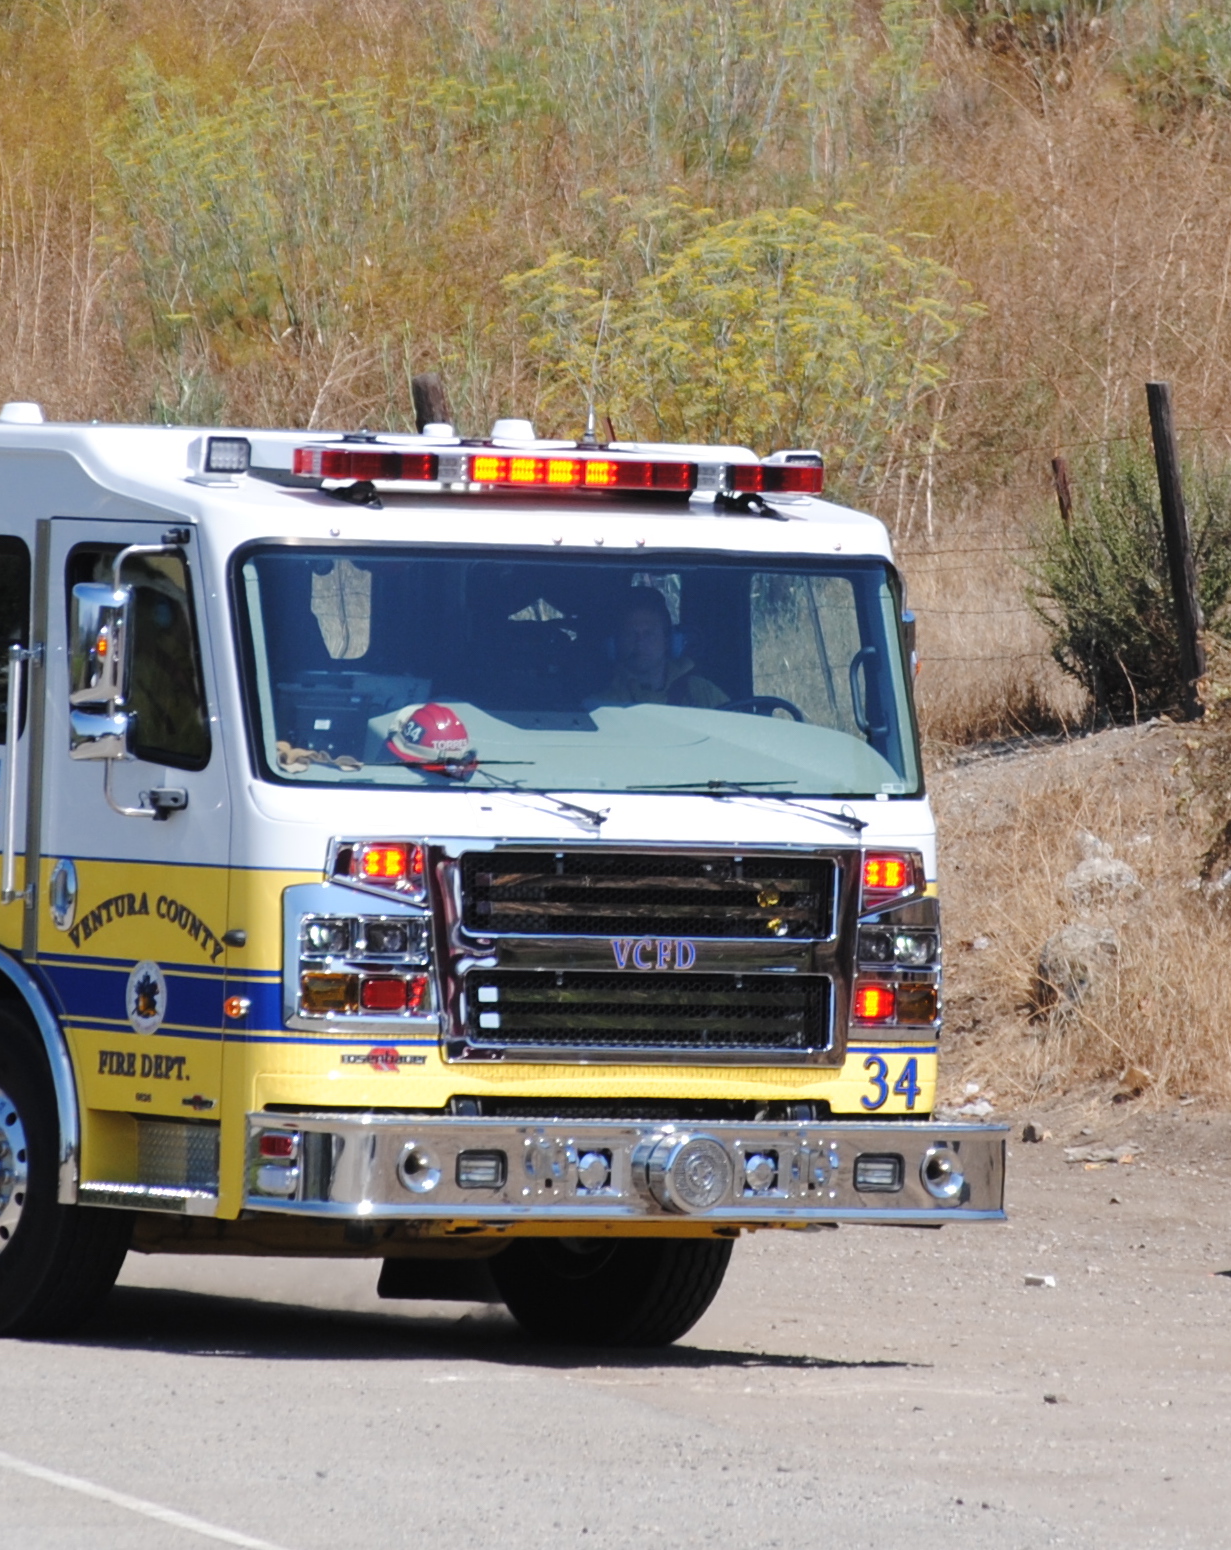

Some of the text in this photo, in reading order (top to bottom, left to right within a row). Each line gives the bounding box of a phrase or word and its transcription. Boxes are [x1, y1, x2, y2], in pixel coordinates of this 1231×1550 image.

[404, 720, 423, 742] 34
[68, 891, 224, 964] VENTURA COUNTY
[609, 936, 696, 970] VCFD
[97, 1050, 190, 1081] FIRE DEPT.
[859, 1054, 922, 1111] 34
